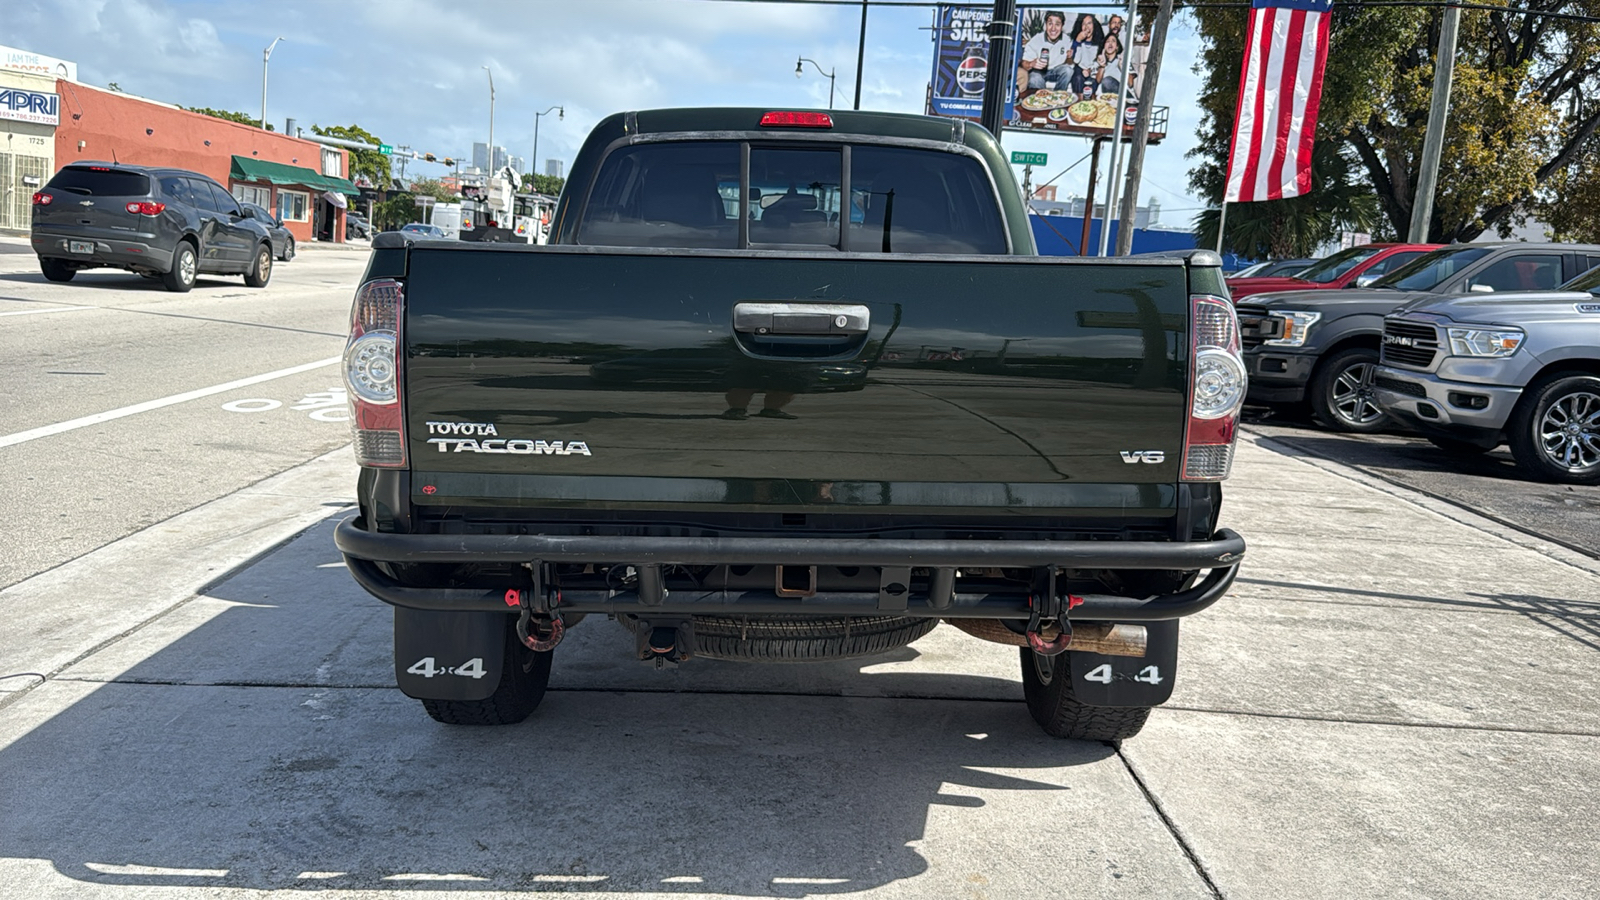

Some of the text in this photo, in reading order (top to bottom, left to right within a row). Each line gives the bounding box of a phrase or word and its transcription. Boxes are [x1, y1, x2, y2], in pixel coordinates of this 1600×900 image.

[11, 53, 24, 63] AM
[25, 55, 39, 65] THE
[29, 137, 45, 146] 1725
[1014, 153, 1045, 163] SW 17 Ct
[1387, 335, 1412, 346] RAM
[426, 421, 498, 436] TOYOTA
[427, 438, 592, 456] TACOMA
[1119, 450, 1165, 464] V6
[406, 656, 488, 679] 4x4
[1084, 663, 1164, 685] 44
